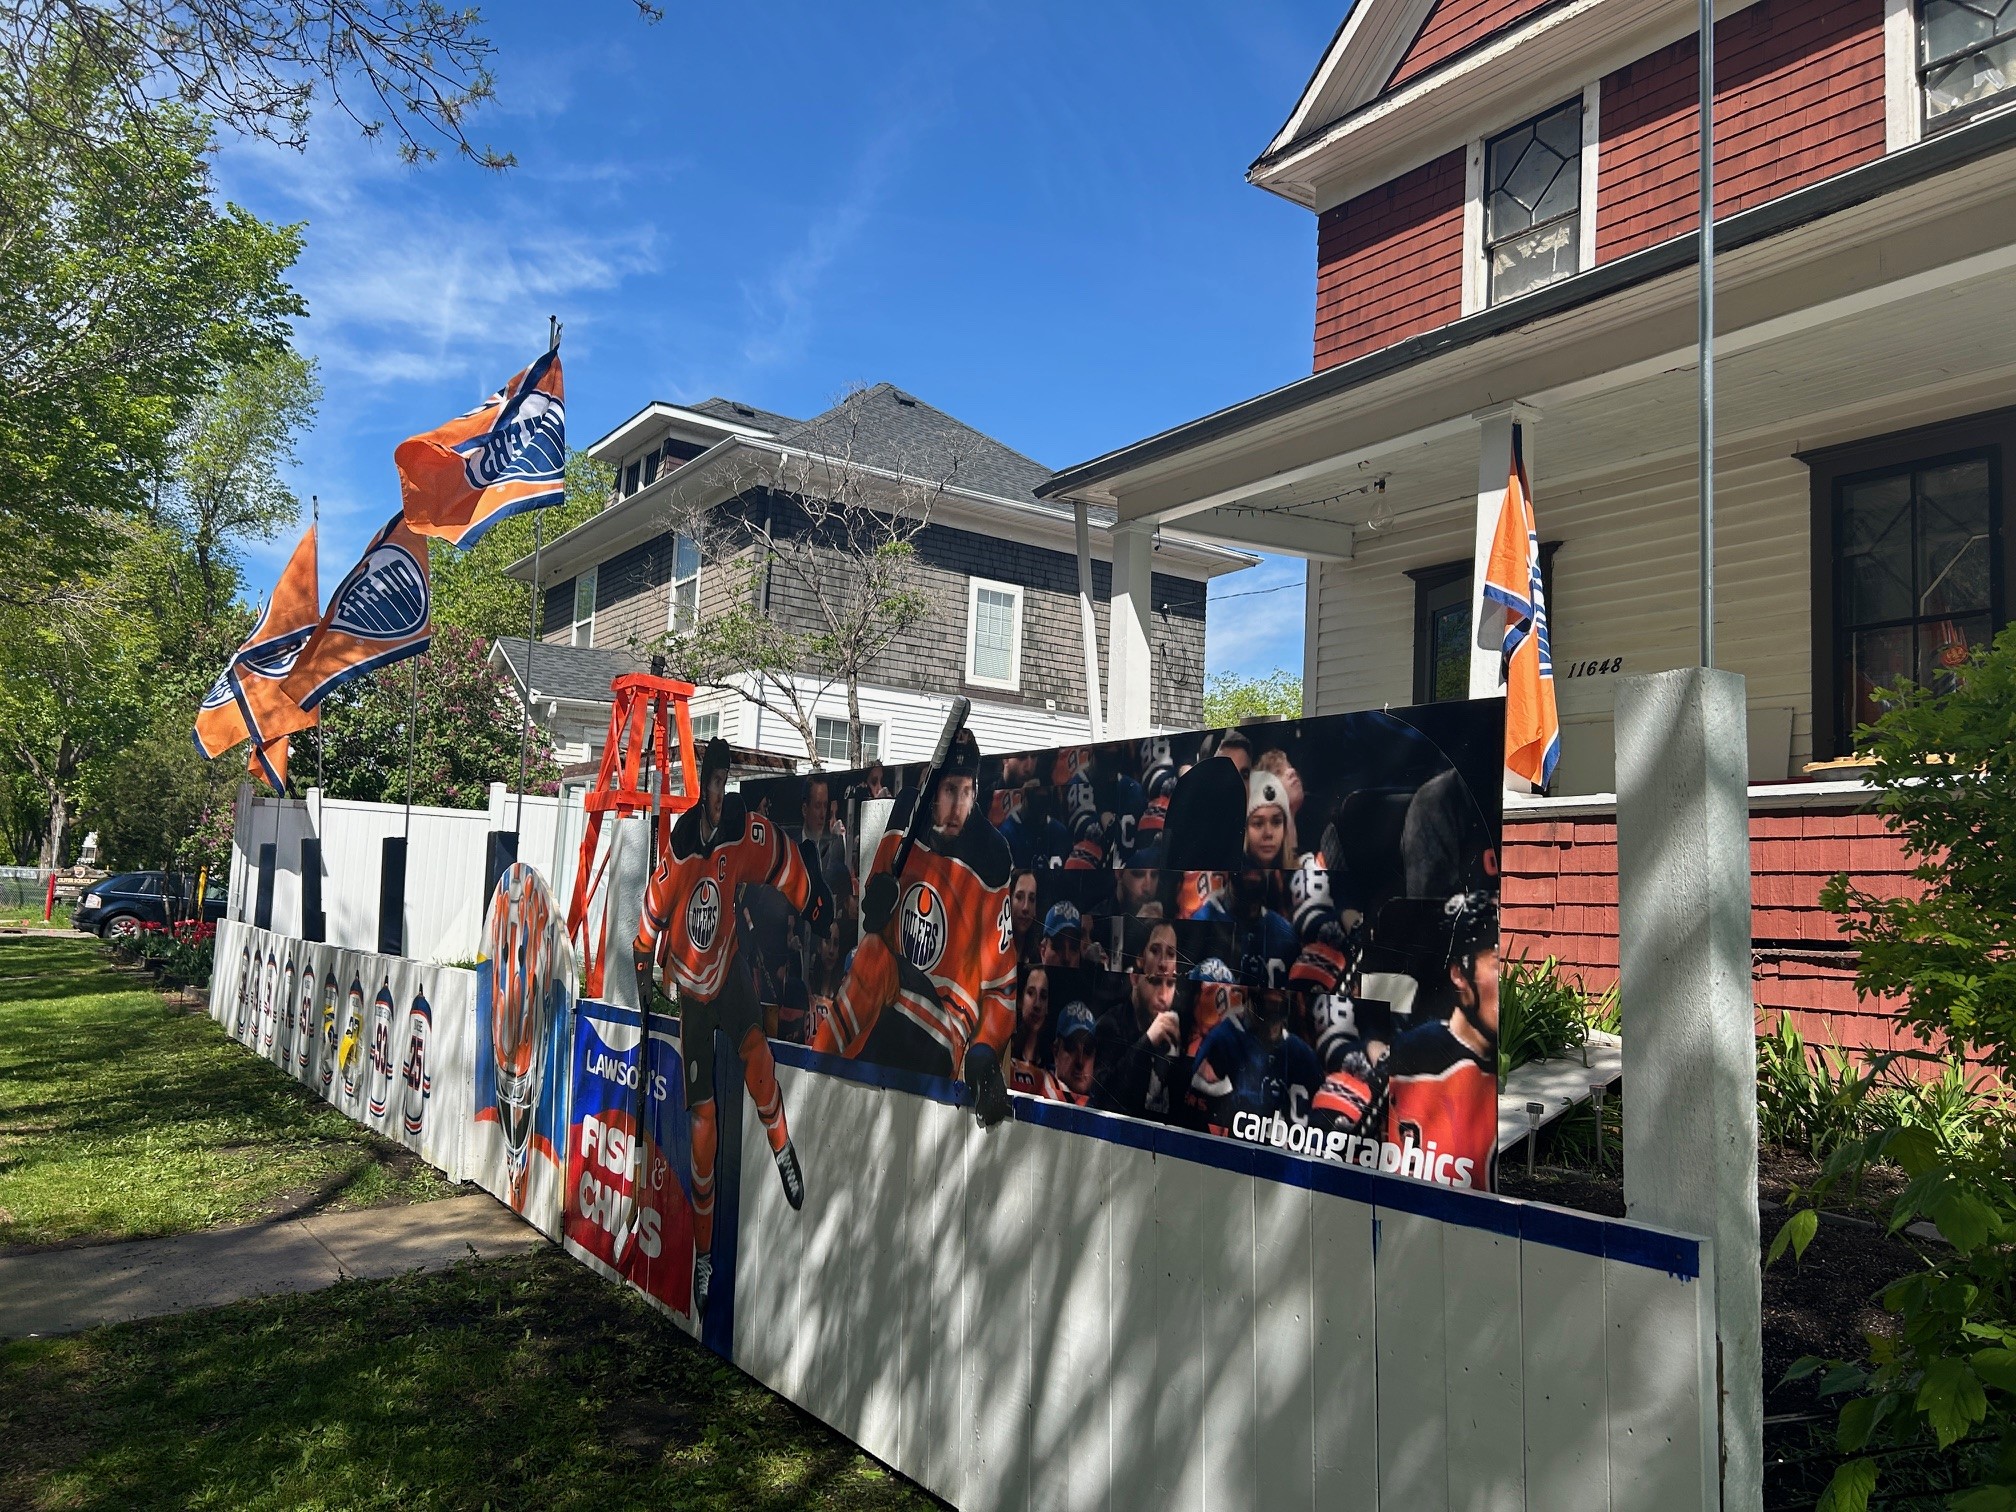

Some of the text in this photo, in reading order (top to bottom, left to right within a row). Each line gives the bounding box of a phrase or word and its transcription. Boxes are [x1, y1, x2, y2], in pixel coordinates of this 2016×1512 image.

[1567, 657, 1623, 679] 11648
[717, 855, 727, 882] C
[691, 905, 718, 947] OILERS
[375, 1022, 388, 1075] 93
[407, 1034, 424, 1092] 25
[586, 1049, 667, 1101] LAWSO'S
[1232, 1110, 1474, 1188] carbongraphics
[651, 1157, 667, 1191] &
